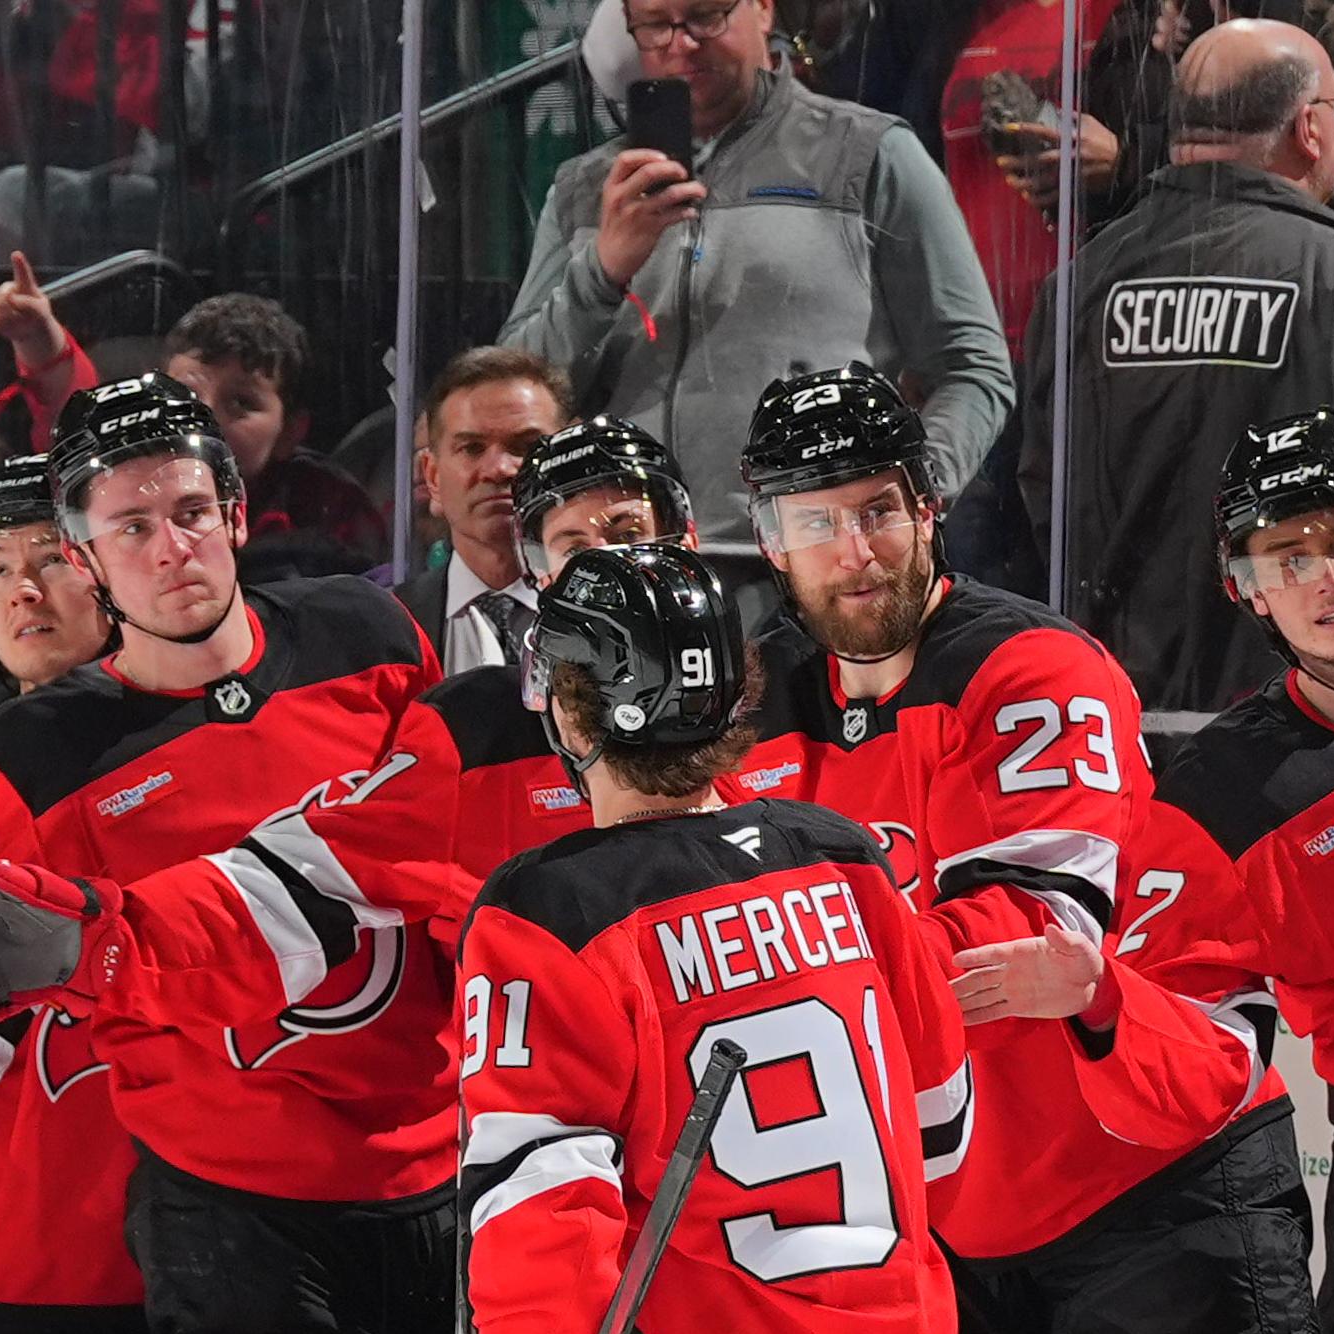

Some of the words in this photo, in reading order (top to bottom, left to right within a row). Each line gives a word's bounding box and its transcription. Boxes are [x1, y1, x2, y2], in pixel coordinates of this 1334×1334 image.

[1110, 291, 1279, 358] SECURITY
[792, 384, 841, 414] 23
[100, 408, 160, 434] CCM
[540, 445, 595, 472] BAUER
[801, 436, 855, 459] CCM
[1260, 463, 1323, 490] CCM
[681, 649, 714, 687] 91
[996, 696, 1122, 795] 23
[463, 974, 532, 1080] 91
[685, 984, 899, 1284] 91
